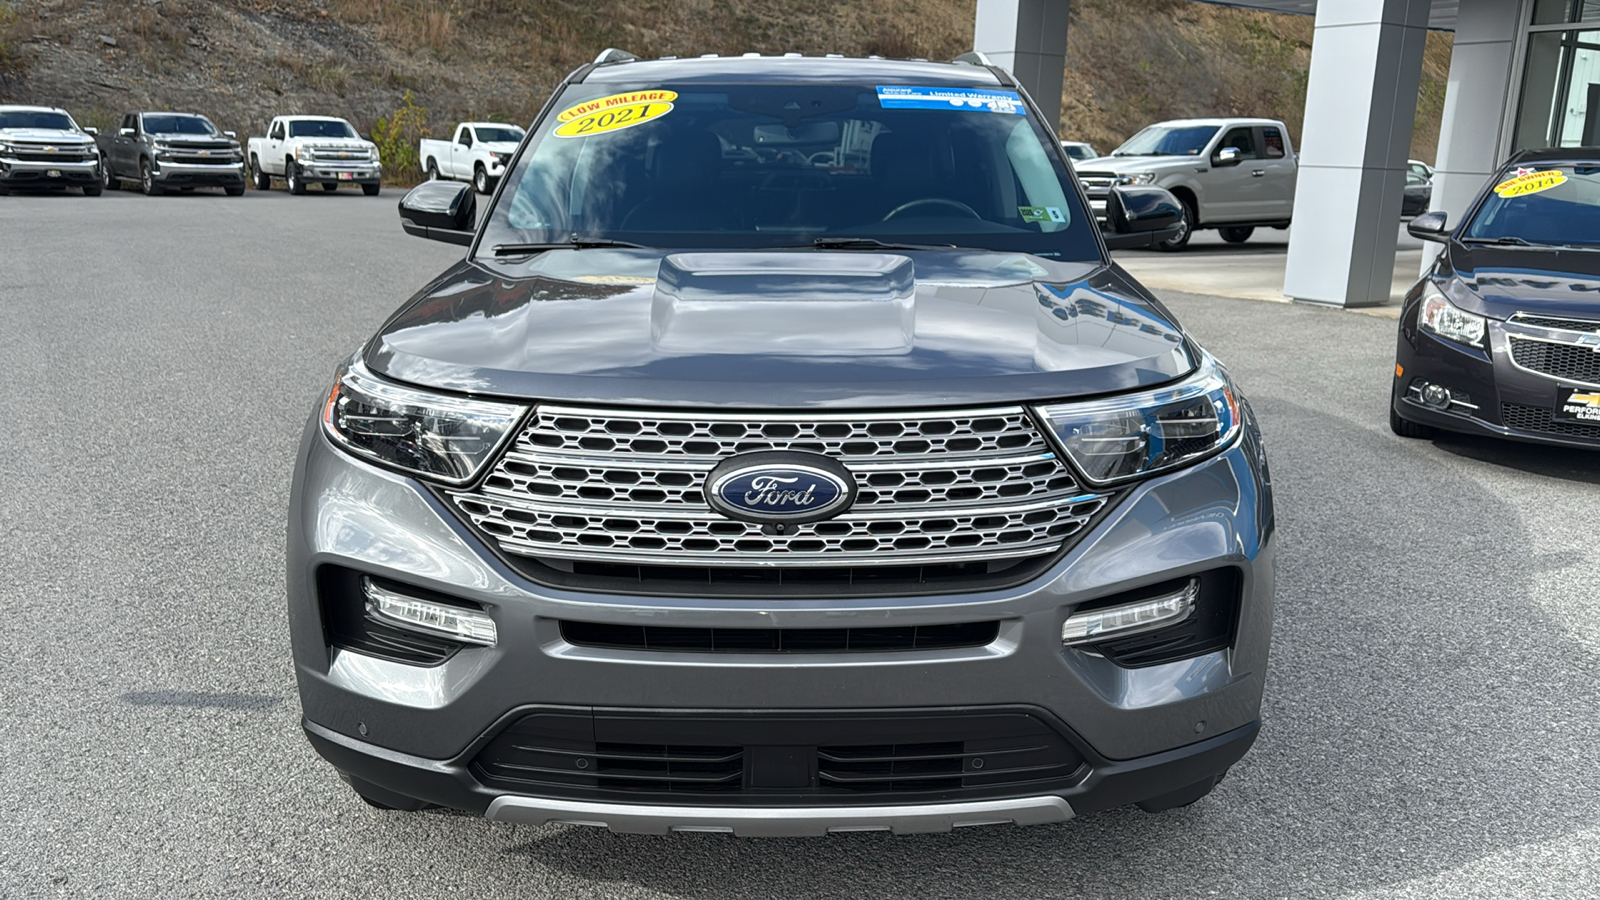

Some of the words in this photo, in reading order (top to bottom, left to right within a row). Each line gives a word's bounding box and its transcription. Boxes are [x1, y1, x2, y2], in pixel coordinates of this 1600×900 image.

[568, 102, 600, 118] LOW
[605, 92, 667, 107] MILEAGE
[929, 90, 966, 98] Limited
[967, 92, 1013, 101] Warranty
[576, 104, 651, 134] 2021
[1512, 177, 1555, 195] 2014
[1563, 405, 1600, 414] PERFOR
[744, 475, 817, 506] Ford
